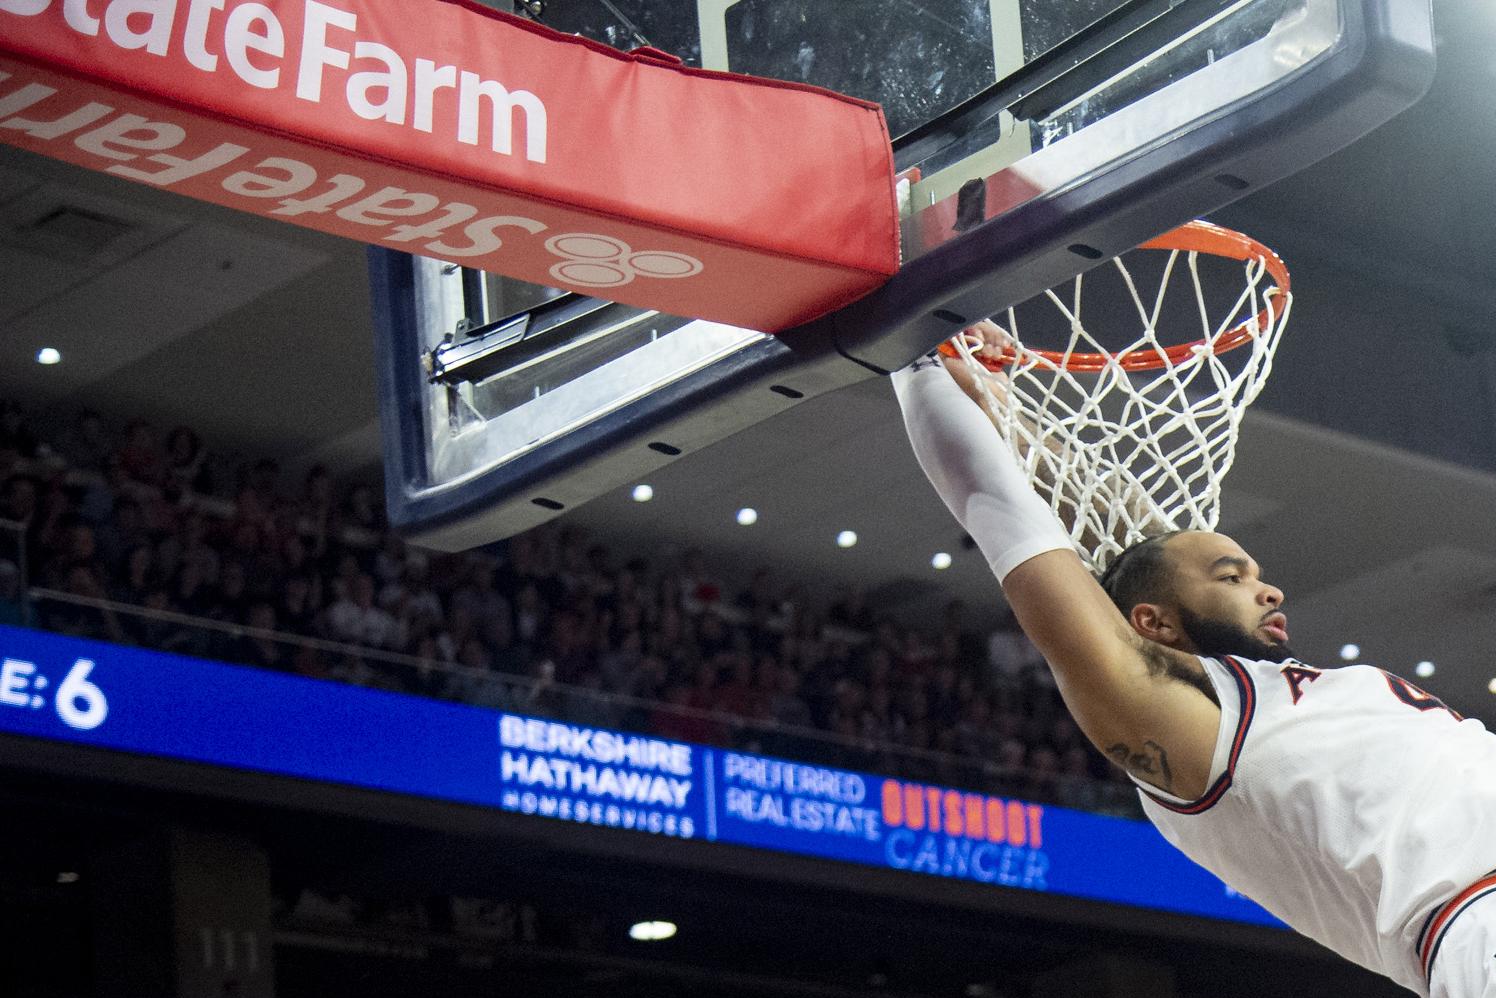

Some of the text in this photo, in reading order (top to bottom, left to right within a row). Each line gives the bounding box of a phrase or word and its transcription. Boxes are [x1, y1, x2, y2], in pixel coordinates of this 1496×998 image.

[500, 715, 693, 776] BERKSHIRE
[501, 750, 693, 809] HATHAWAY
[881, 778, 1044, 850] OUTSHOOT
[884, 828, 1050, 893] CANCER
